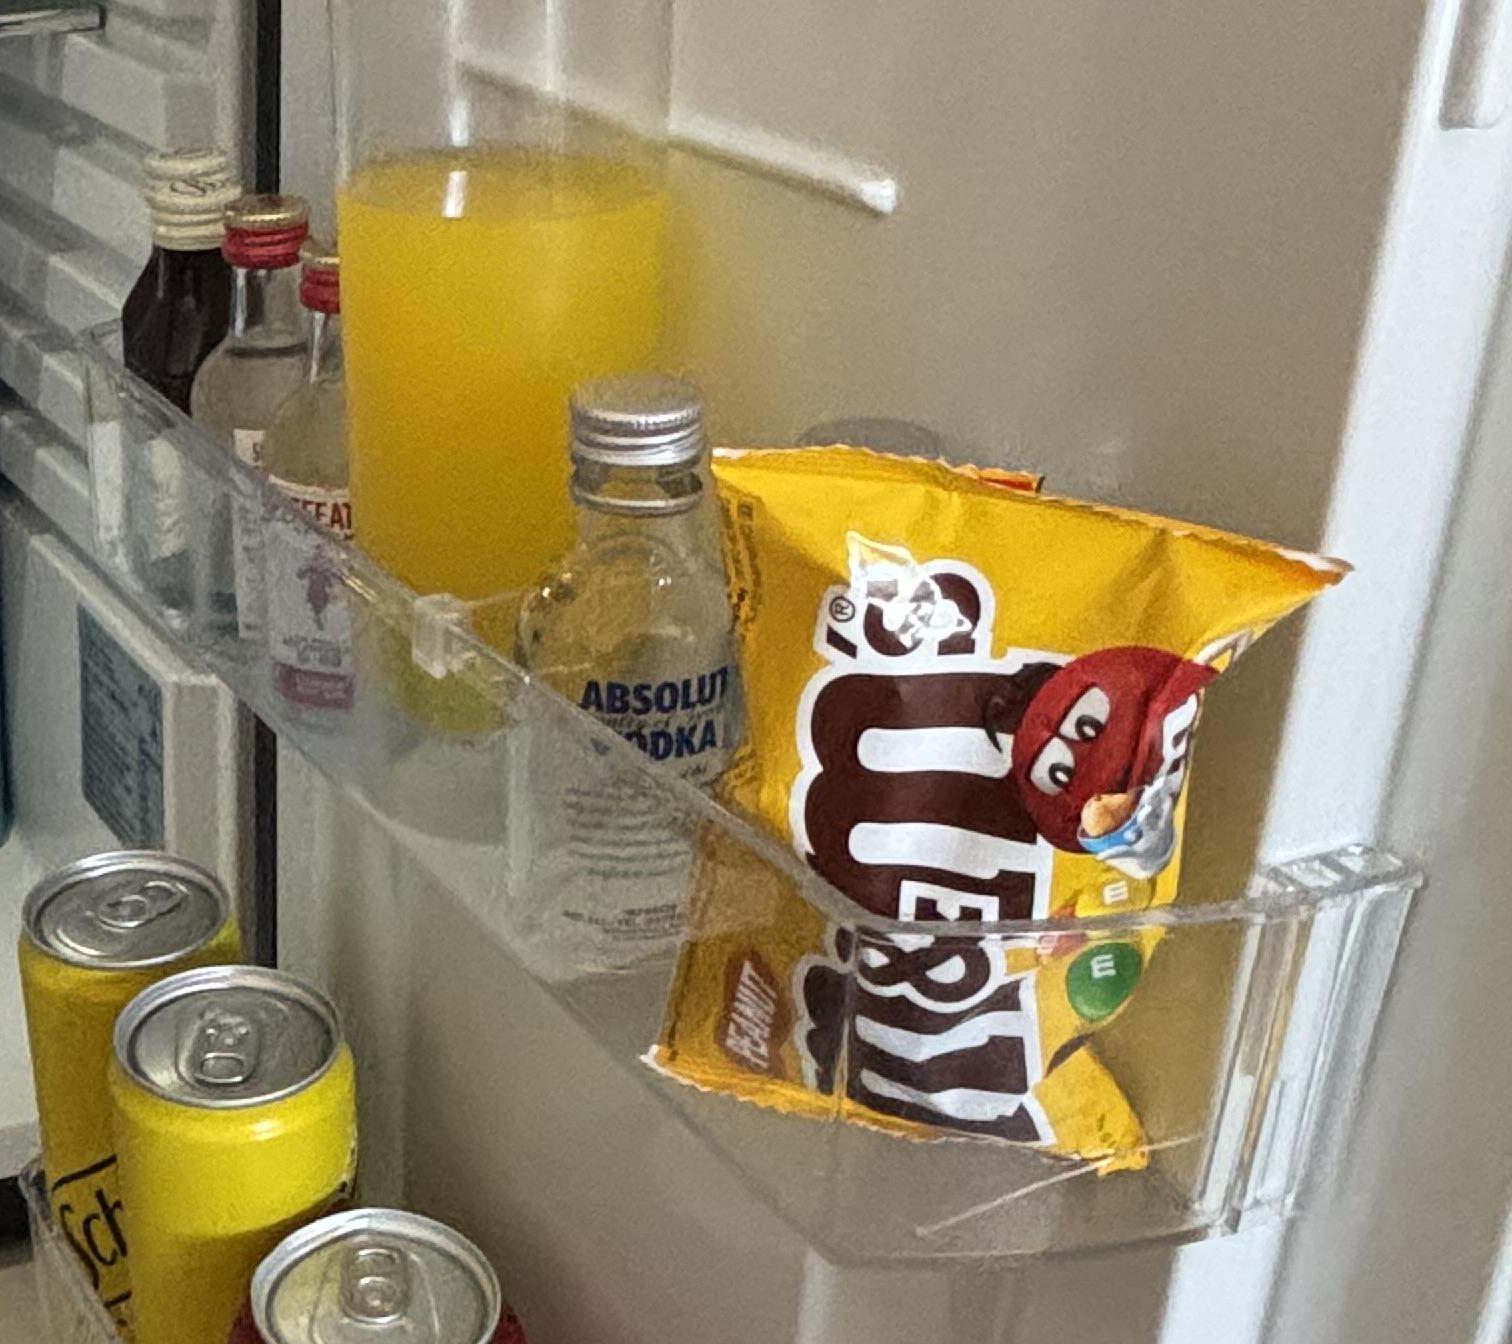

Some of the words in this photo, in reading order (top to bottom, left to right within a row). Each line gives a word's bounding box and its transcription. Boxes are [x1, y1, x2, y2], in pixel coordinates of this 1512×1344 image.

[578, 666, 728, 716] ABSOLUT
[624, 719, 717, 760] ODKA
[726, 959, 778, 1069] PEANUT
